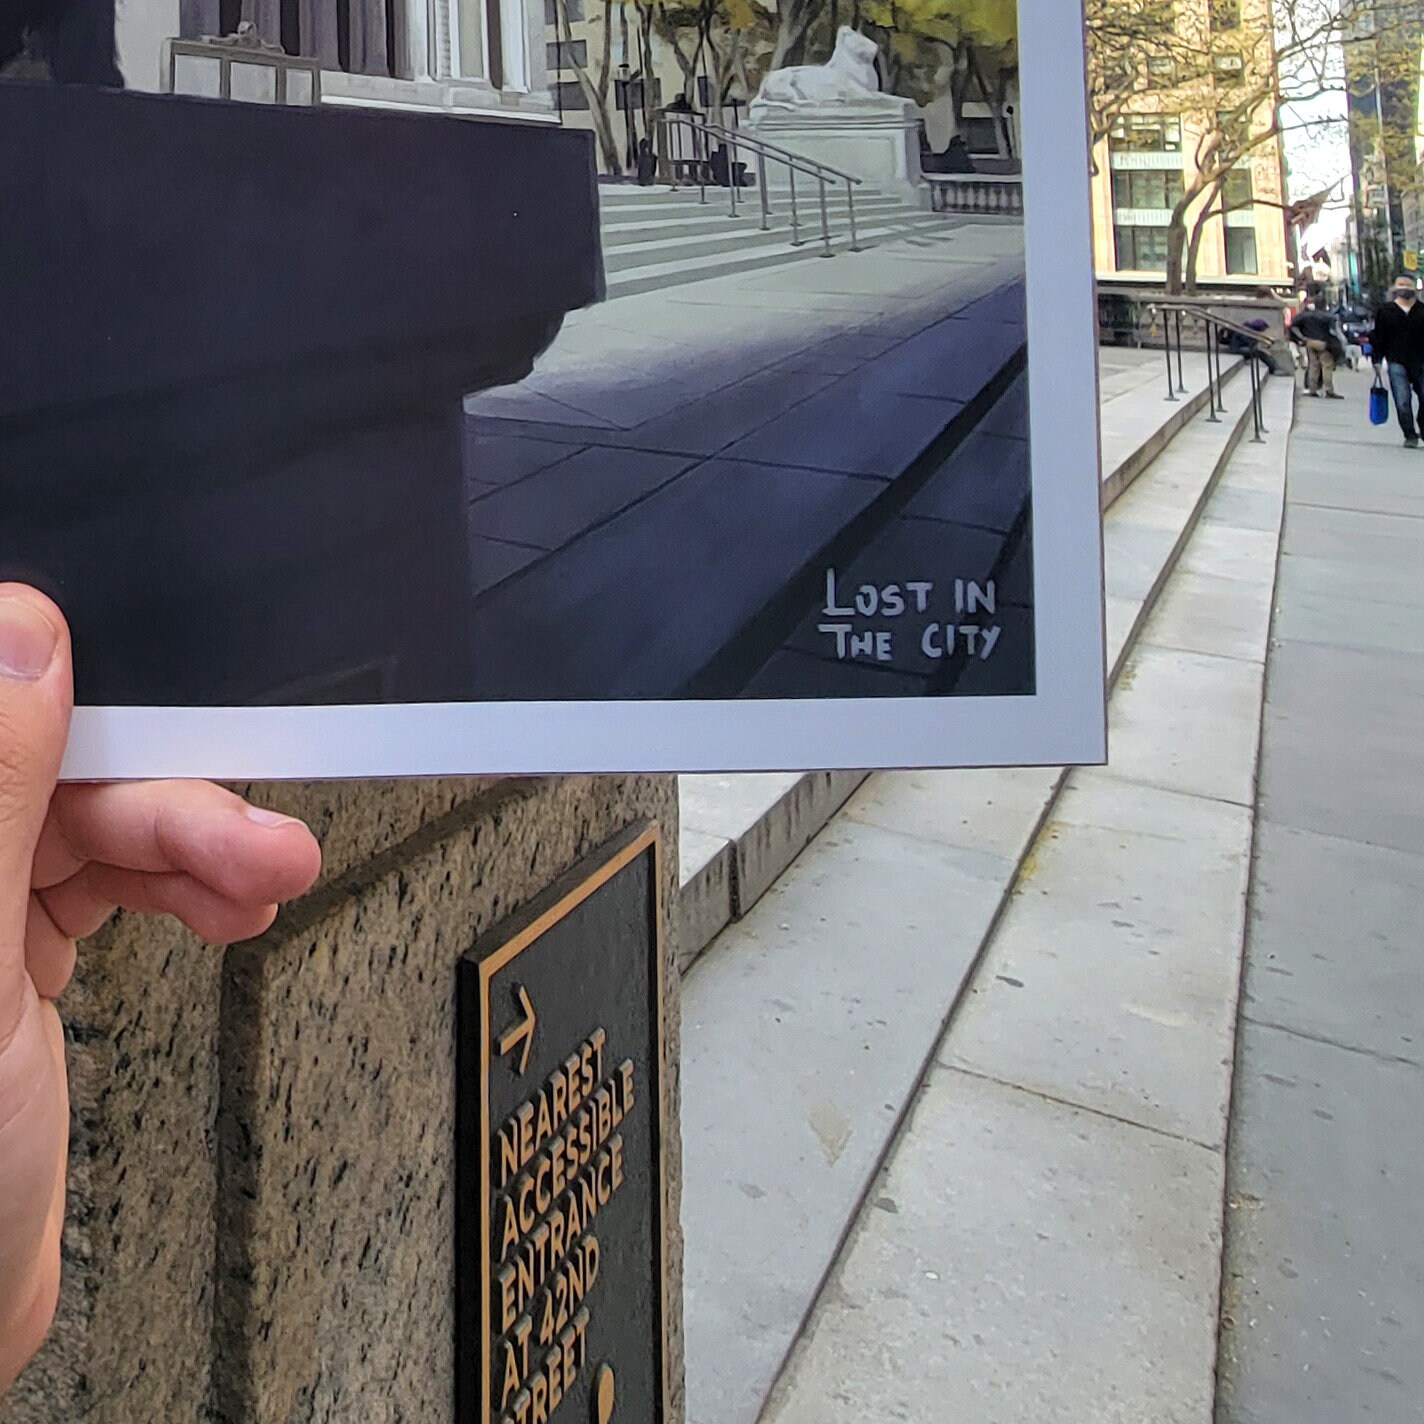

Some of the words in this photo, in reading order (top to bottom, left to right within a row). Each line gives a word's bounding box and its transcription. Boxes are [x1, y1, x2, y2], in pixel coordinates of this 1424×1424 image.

[817, 623, 893, 660] THE
[921, 623, 1001, 660] CITY
[822, 567, 933, 616] LOST
[955, 579, 996, 614] IN
[497, 1027, 606, 1188] NEAREST
[500, 1058, 635, 1263] ACCESSIBLE
[498, 1133, 624, 1334] ENTRANCE
[501, 1314, 533, 1414] AT
[539, 1234, 600, 1346] 42ND
[503, 1305, 591, 1424] TREET
